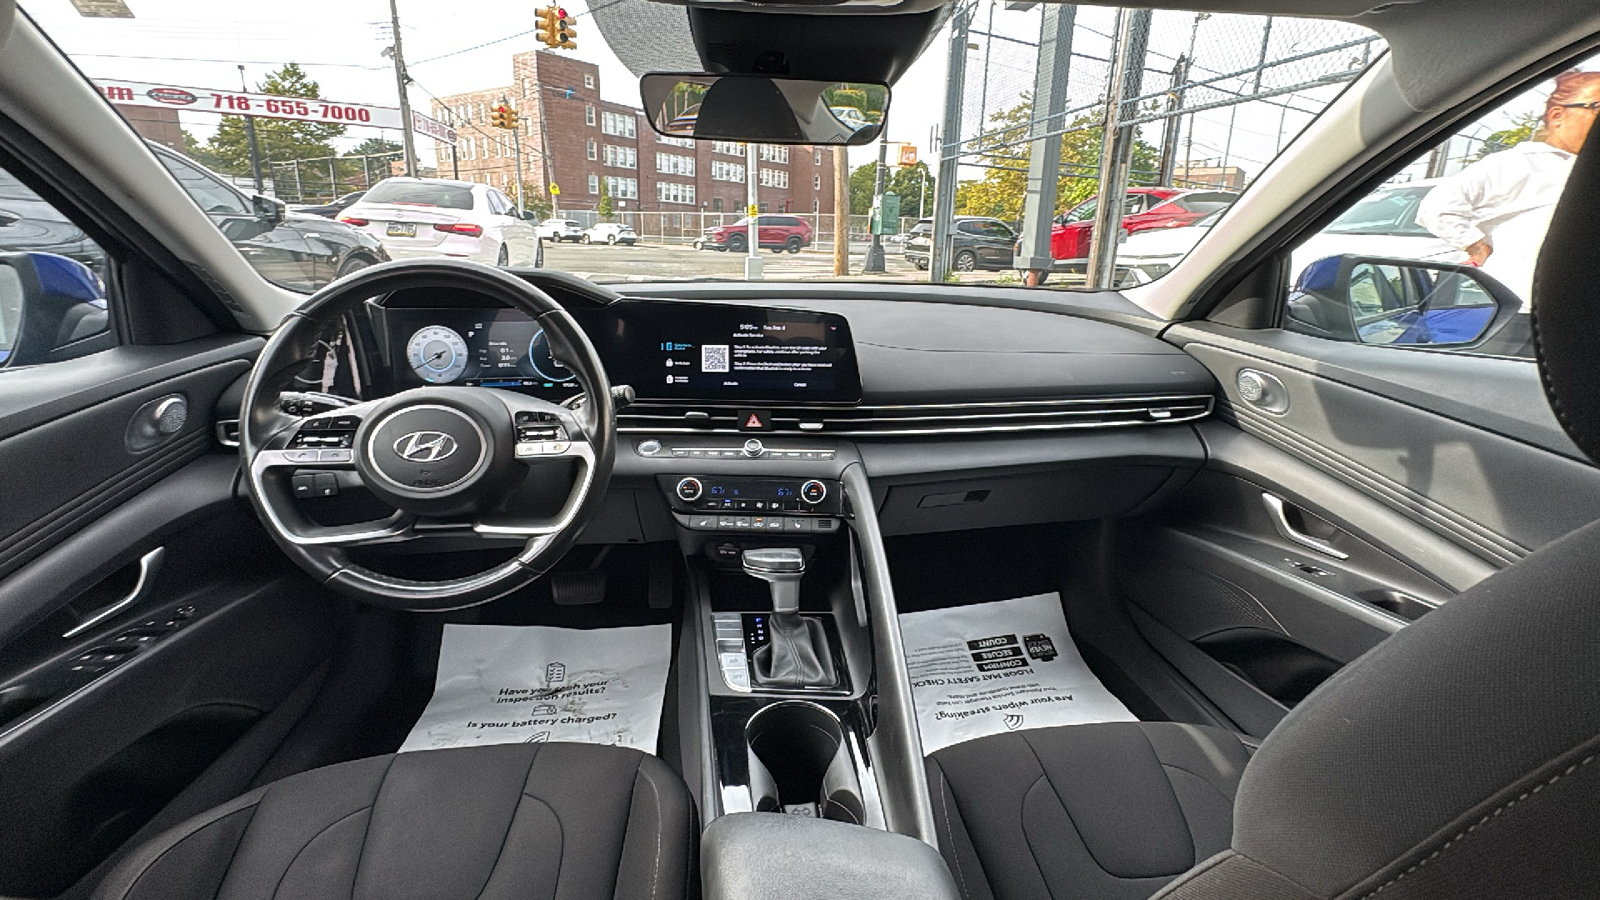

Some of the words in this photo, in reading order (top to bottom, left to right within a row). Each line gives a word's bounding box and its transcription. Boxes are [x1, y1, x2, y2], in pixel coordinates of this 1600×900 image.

[978, 638, 1007, 647] COUNT
[1030, 644, 1052, 653] NEVER
[981, 650, 1013, 659] SECURE
[982, 660, 1022, 670] CONFIRM
[982, 672, 1002, 680] MAT
[1002, 668, 1034, 678] FLOOR
[912, 679, 945, 688] CHECK
[947, 676, 980, 684] SAFETY
[499, 688, 529, 696] Have
[561, 686, 606, 699] results?
[992, 701, 1029, 710] wipers
[935, 707, 991, 720] streaking?
[478, 722, 510, 730] your
[511, 718, 559, 728] battery
[560, 712, 617, 724] charged?
